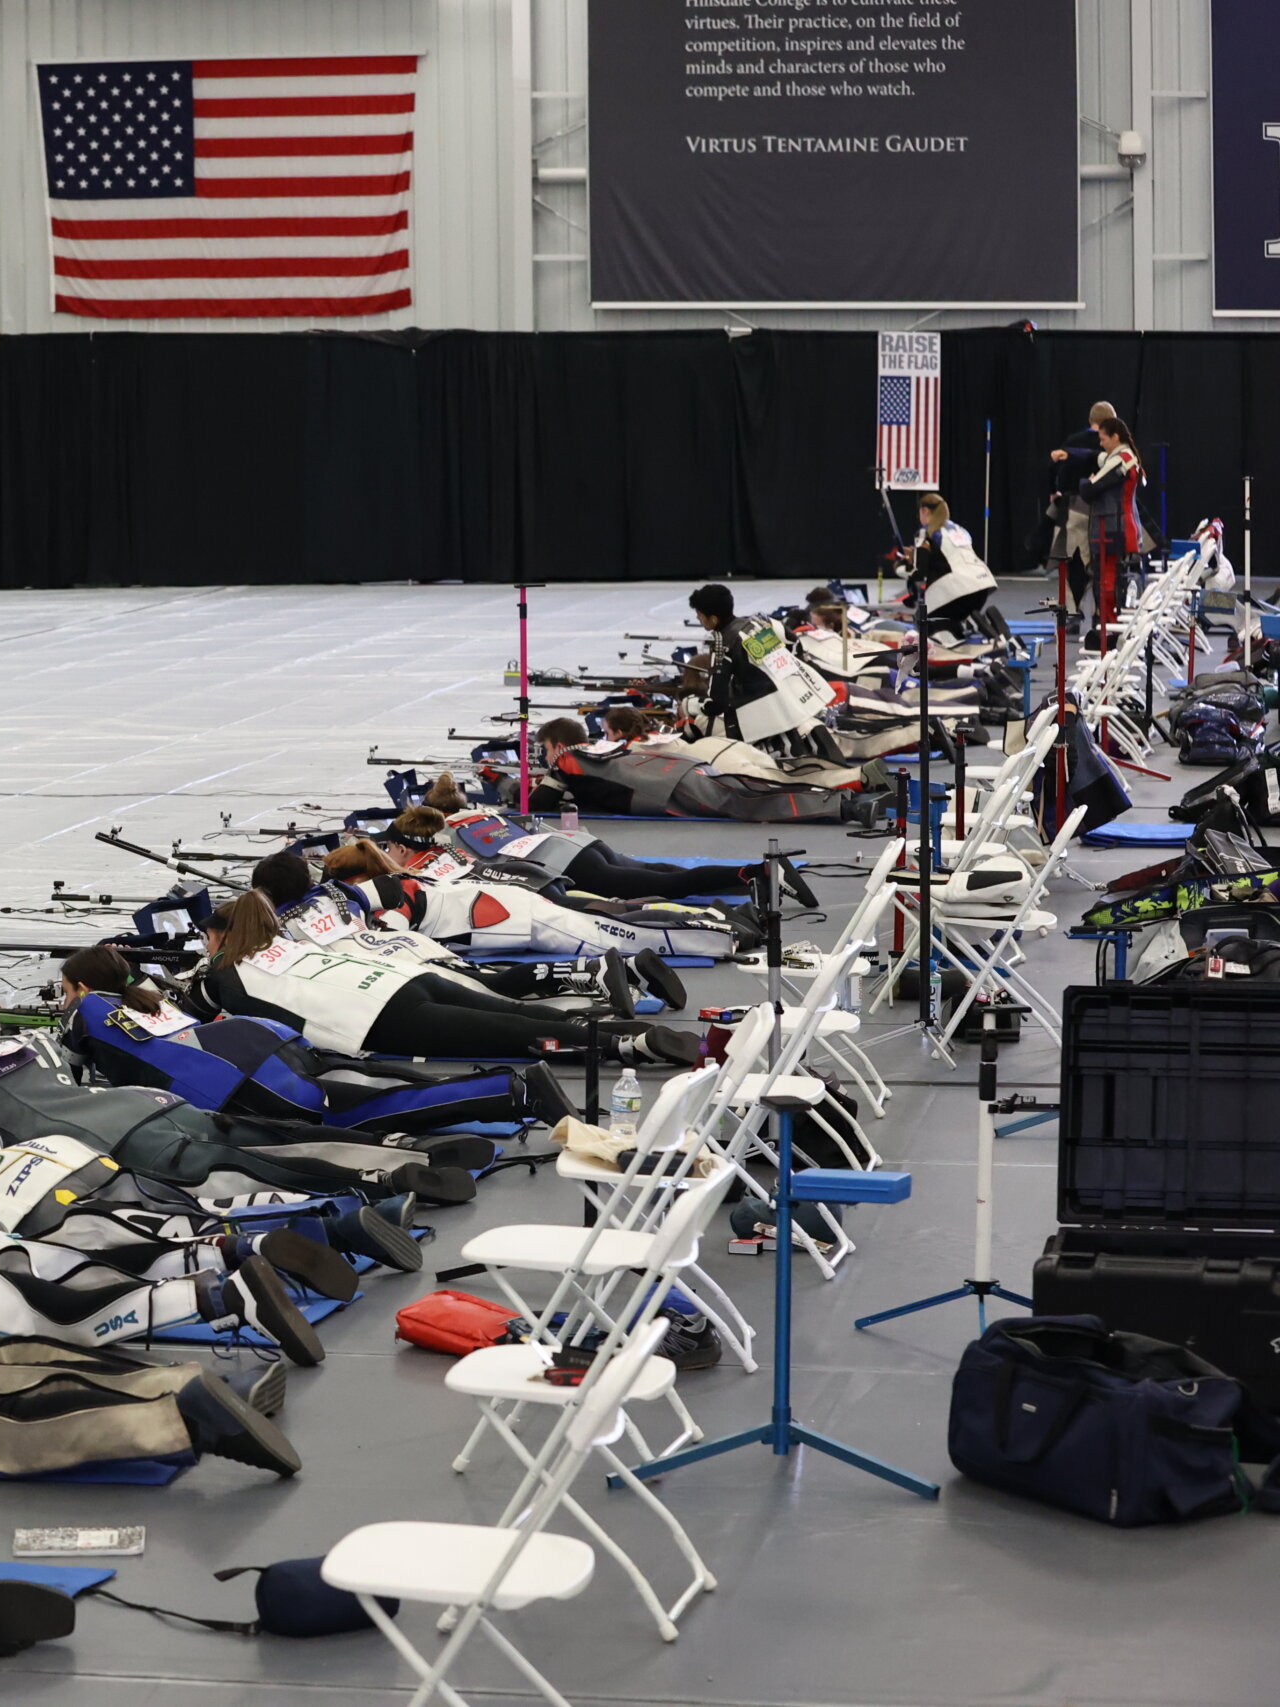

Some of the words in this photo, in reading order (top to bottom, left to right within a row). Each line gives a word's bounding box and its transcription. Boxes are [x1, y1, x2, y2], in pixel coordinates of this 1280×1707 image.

[685, 15, 740, 30] virtues.
[744, 13, 784, 29] Their
[788, 13, 852, 33] practice,
[856, 16, 876, 28] on
[880, 12, 904, 28] the
[908, 11, 940, 28] field
[945, 11, 962, 28] of
[685, 37, 780, 56] competition,
[785, 37, 843, 55] inspires
[846, 35, 875, 51] and
[879, 35, 937, 51] elevates
[941, 34, 965, 50] the
[685, 59, 733, 74] minds
[737, 58, 765, 74] and
[768, 58, 846, 74] characters
[849, 57, 867, 73] of
[869, 57, 909, 73] those
[913, 57, 946, 73] who
[685, 84, 749, 101] compete
[753, 81, 782, 97] and
[786, 81, 826, 97] those
[830, 80, 863, 96] who
[867, 80, 915, 96] watch.
[686, 135, 757, 153] VIRTUS
[762, 135, 879, 152] TENTAMINE
[885, 134, 968, 152] GAUDET
[881, 334, 938, 354] RAISE
[881, 354, 904, 370] THE
[907, 354, 938, 370] FLAG
[433, 863, 456, 878] 400
[310, 914, 336, 934] 327
[260, 944, 288, 963] 307
[379, 945, 403, 956] SA
[358, 970, 385, 990] USA
[5, 1156, 45, 1198] ZIPS
[93, 1309, 139, 1338] USA
